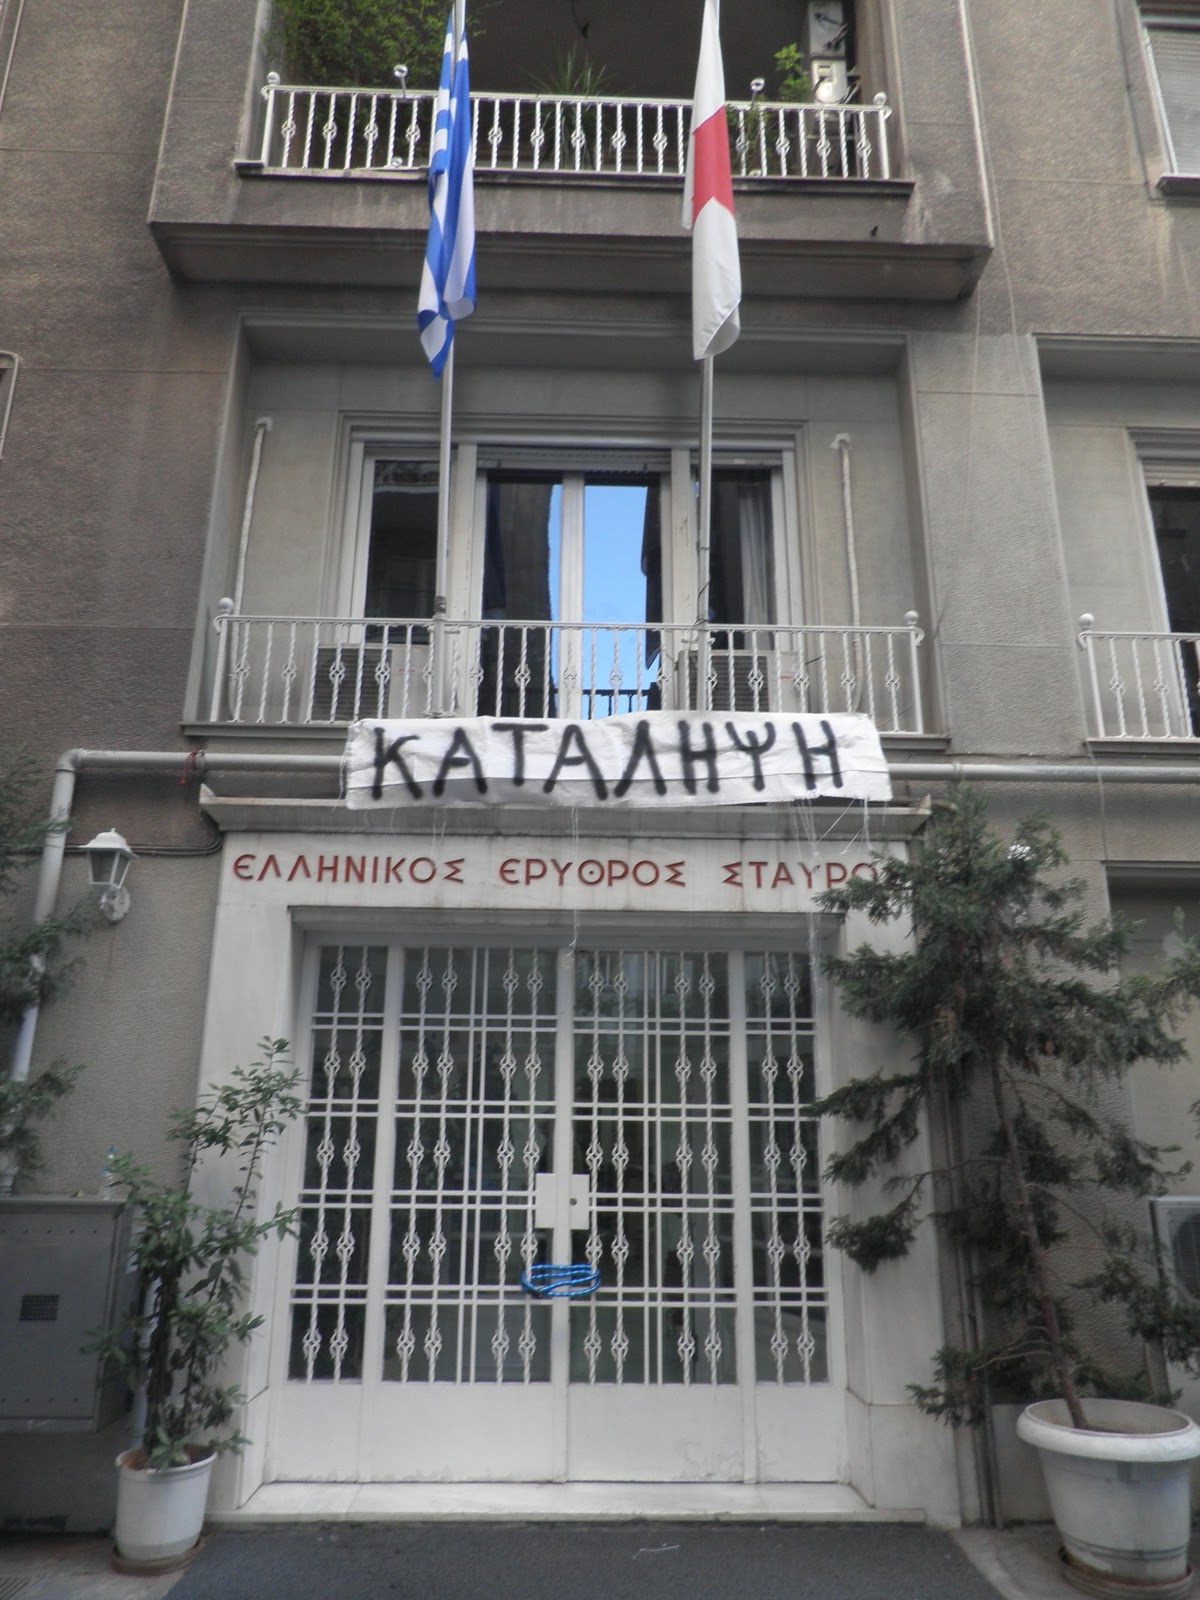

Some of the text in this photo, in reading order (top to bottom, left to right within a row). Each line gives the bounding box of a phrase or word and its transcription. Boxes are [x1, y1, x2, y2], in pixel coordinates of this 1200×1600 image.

[370, 719, 845, 800] ΚΑΤΑΛΗΨΗ
[232, 853, 878, 889] ΕΛΛΗΝΙΚΟΣ ΕΡΥΘΡΟΣ ΣΤΑΥΡΟ
